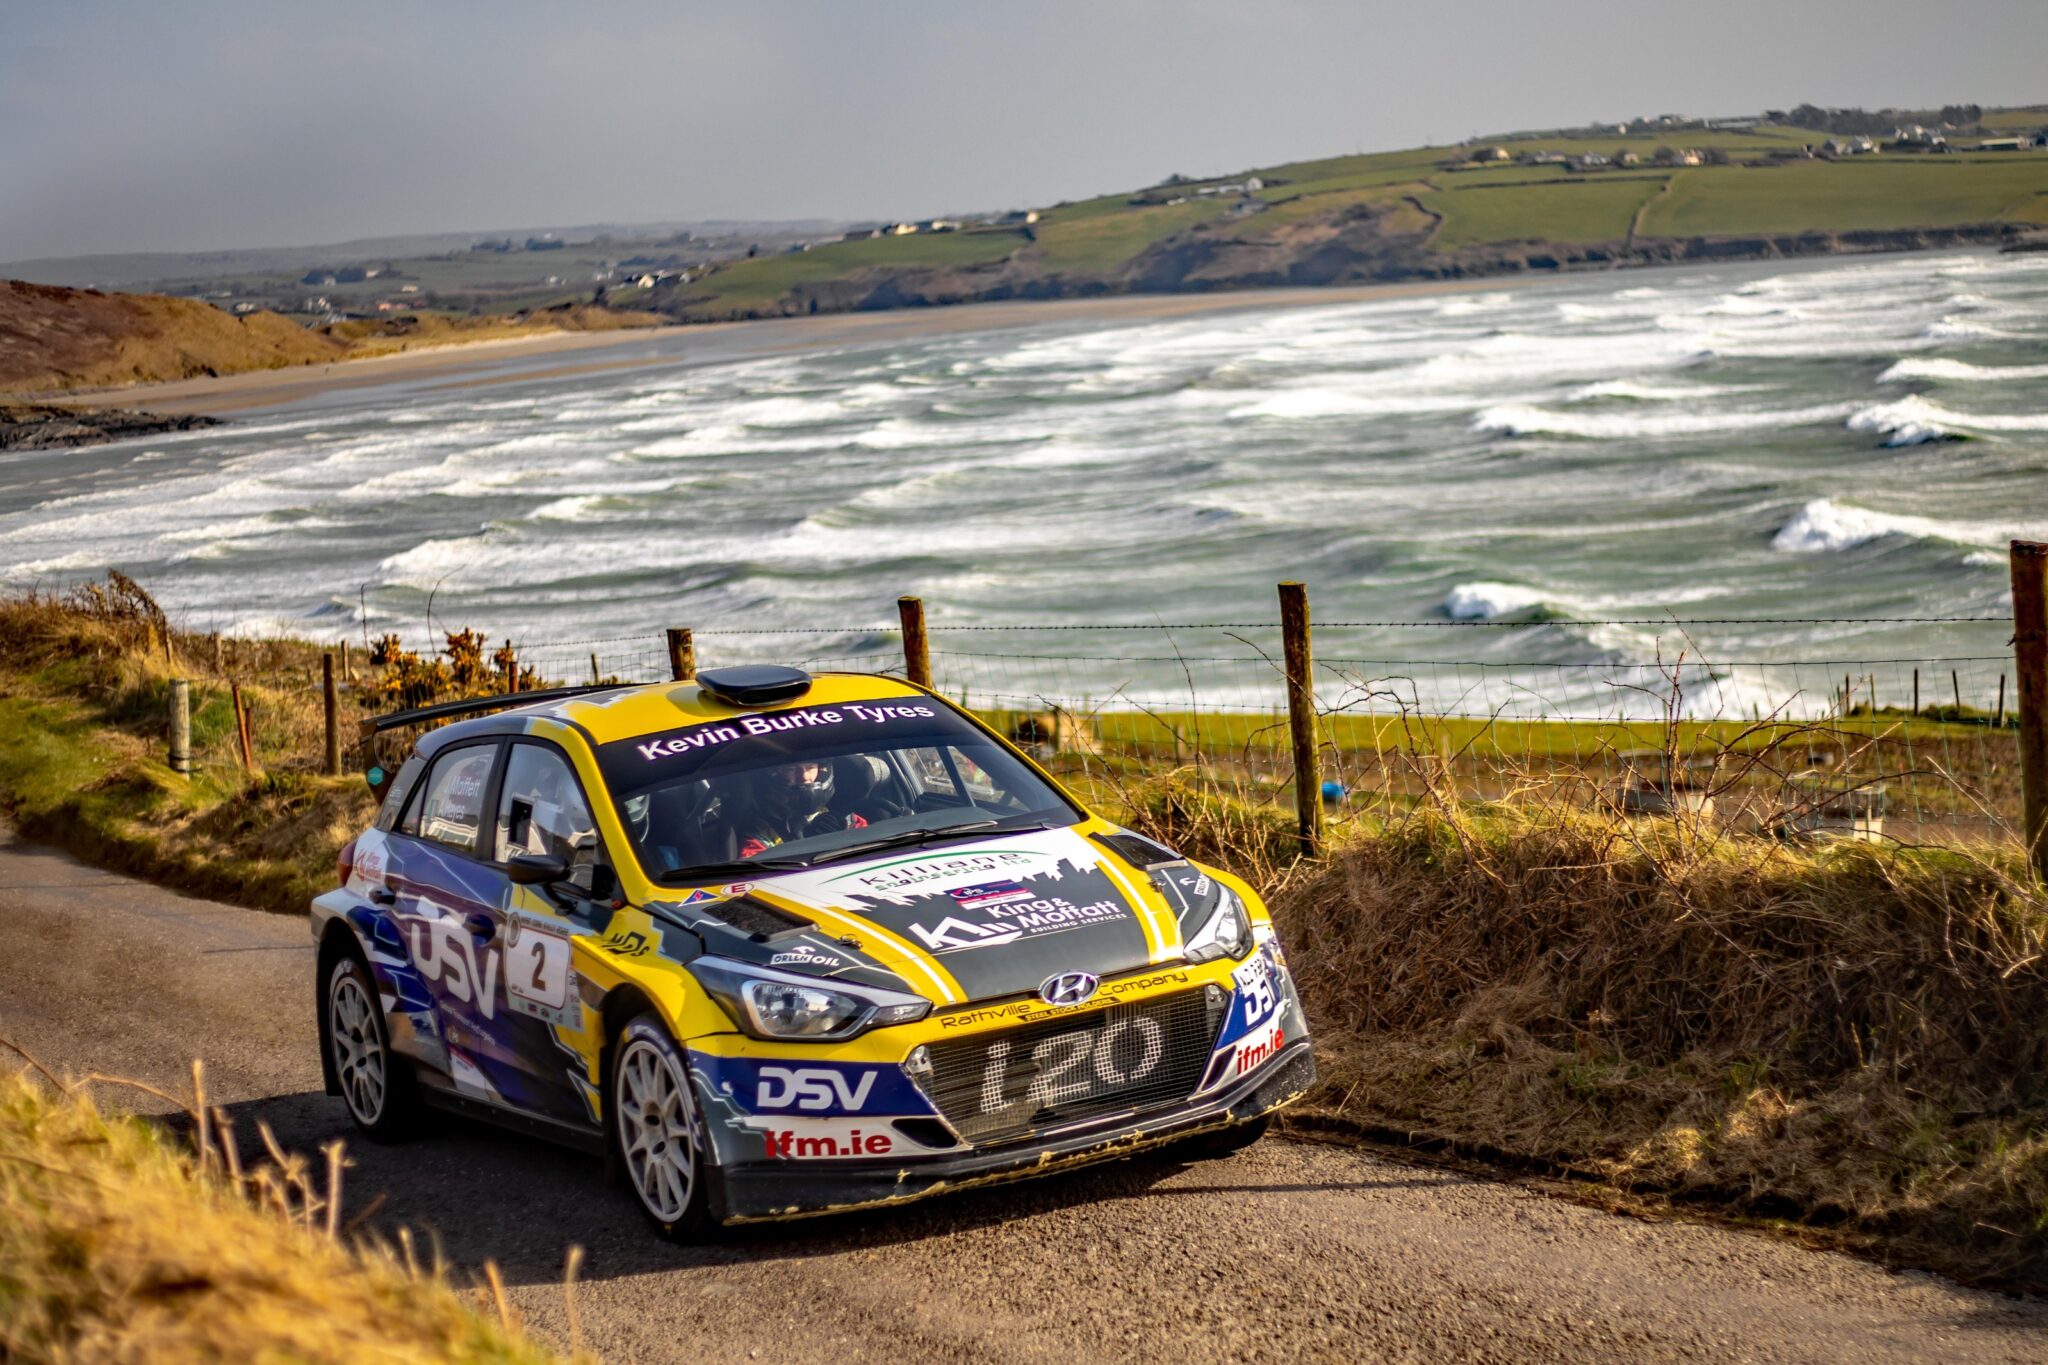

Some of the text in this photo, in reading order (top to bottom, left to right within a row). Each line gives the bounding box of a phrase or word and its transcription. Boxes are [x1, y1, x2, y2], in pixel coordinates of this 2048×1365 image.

[637, 703, 935, 761] Kevin Burke Tyres
[1018, 900, 1121, 930] Moffatt
[1030, 912, 1127, 933] BUILDING SERVICES
[530, 942, 547, 992] 2
[772, 954, 840, 967] ORLEN OIL
[941, 971, 1188, 1029] Rathville Company
[1235, 1028, 1286, 1075] ifm.ie
[757, 1066, 878, 1111] DSV
[765, 1129, 892, 1159] ifm.ie
